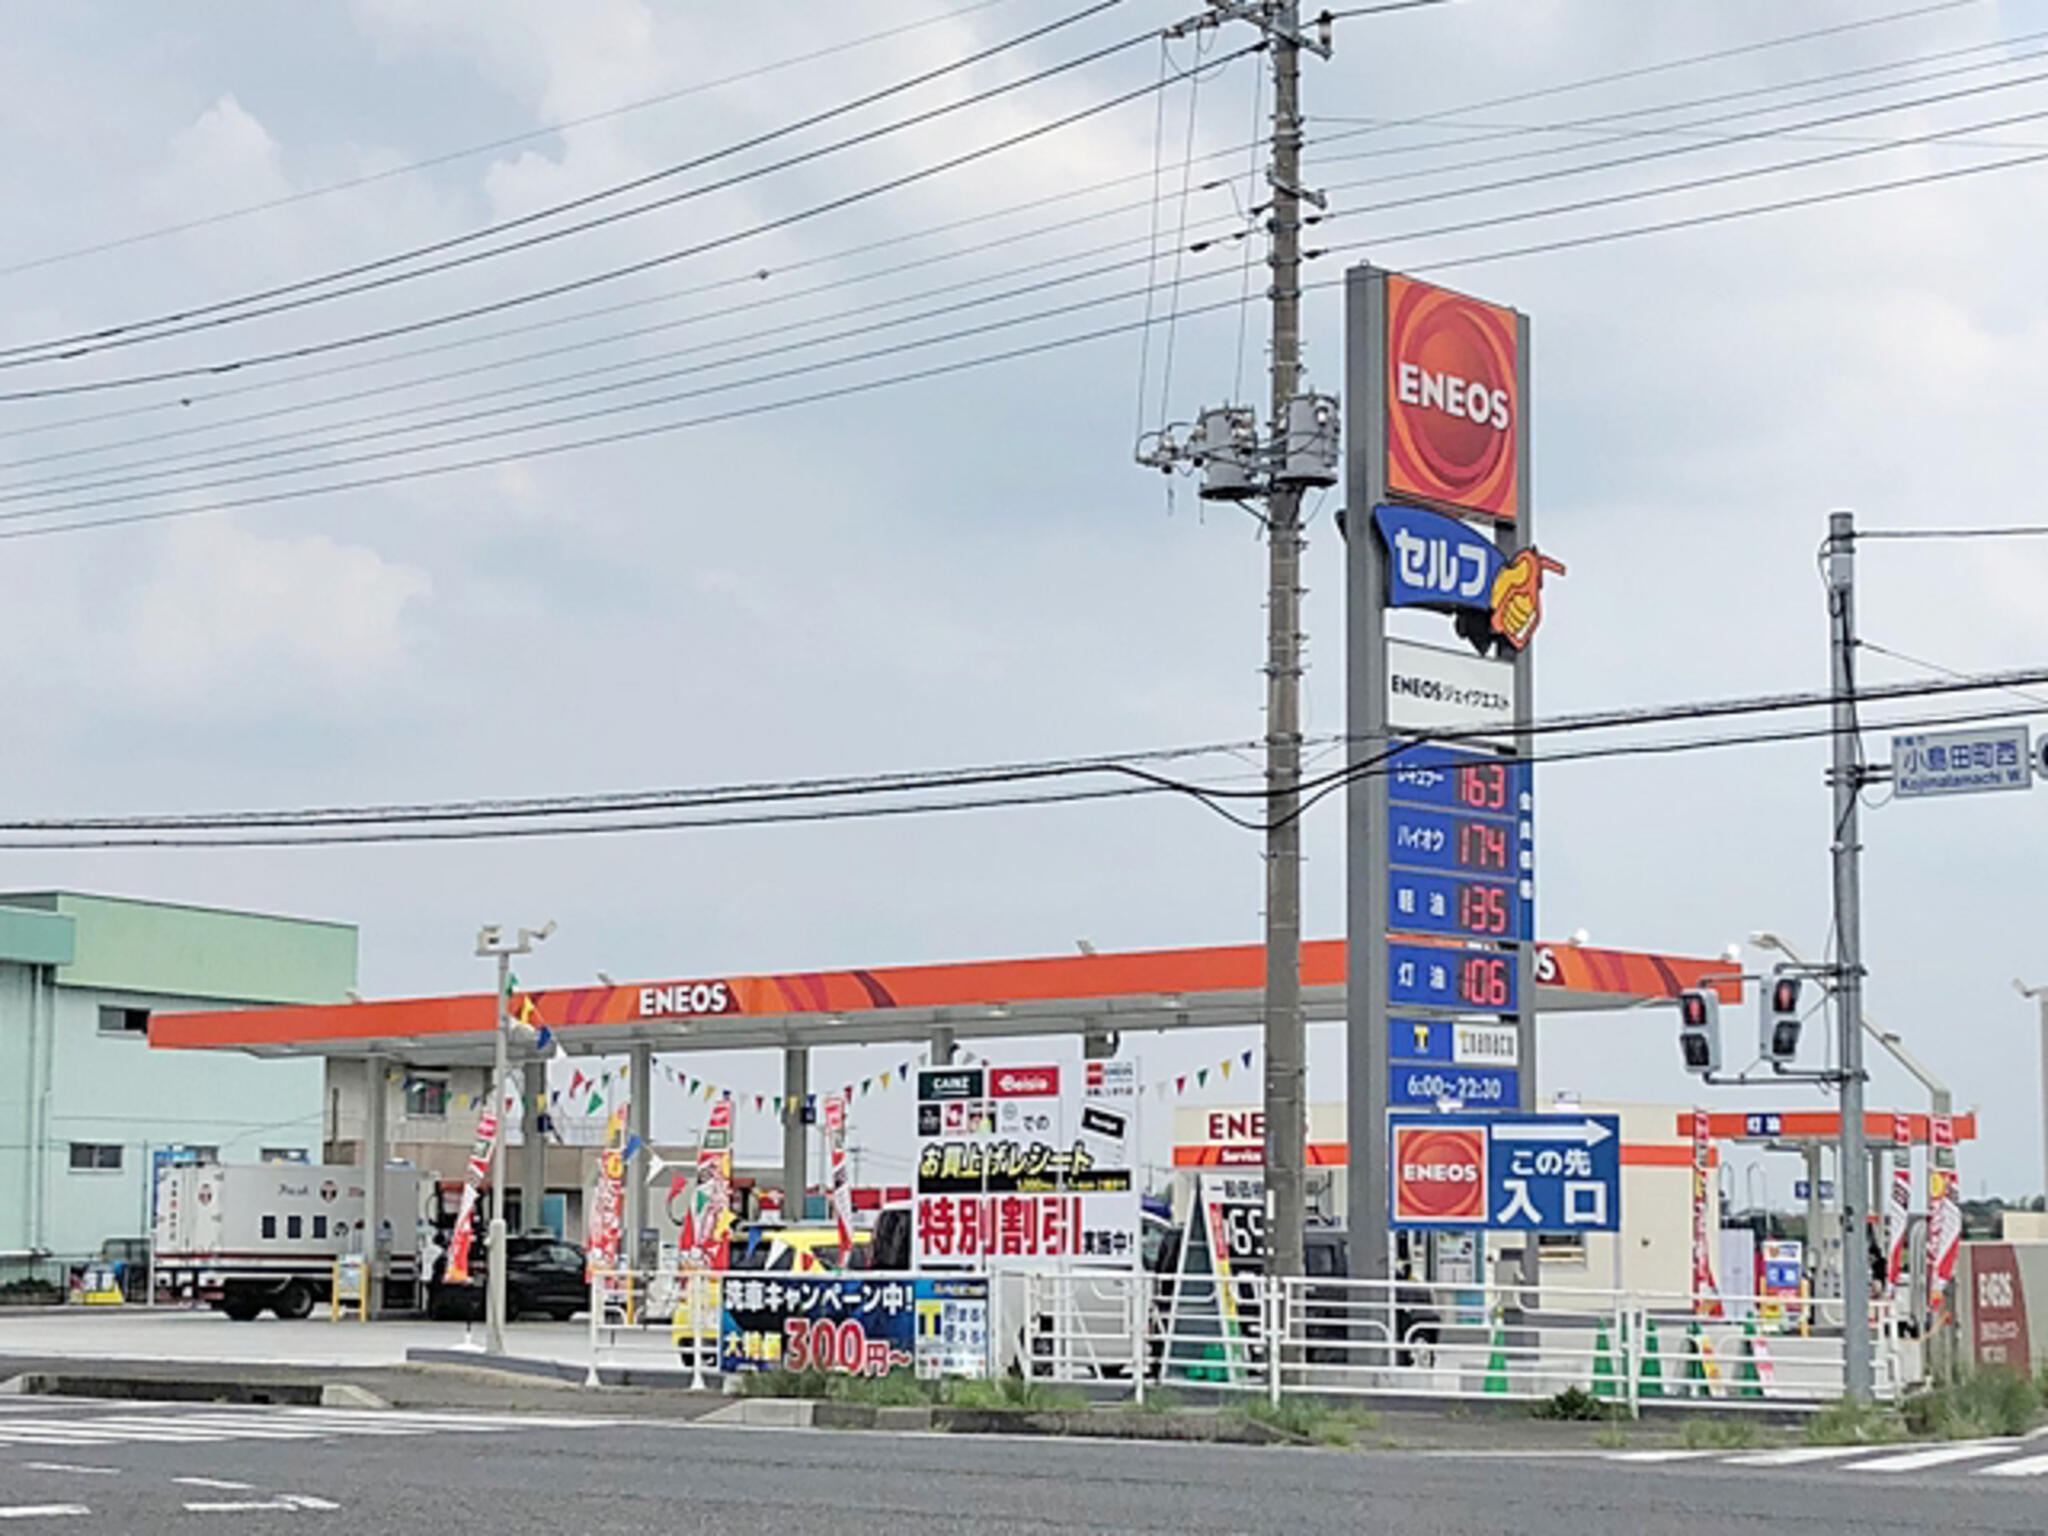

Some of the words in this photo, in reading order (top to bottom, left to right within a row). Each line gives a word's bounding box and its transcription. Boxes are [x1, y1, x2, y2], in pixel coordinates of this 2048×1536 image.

[1399, 362, 1509, 430] ENEOS
[1395, 528, 1488, 597] セルフ
[1461, 763, 1505, 807] 163
[1461, 824, 1505, 869] 174
[1461, 885, 1505, 933] 135
[639, 984, 727, 1016] ENEOS
[1463, 959, 1505, 1005] 106
[1023, 1115, 1050, 1131] での
[1209, 1113, 1266, 1140] ENE
[1402, 1163, 1478, 1182] ENEOS
[1511, 1149, 1592, 1176] この先
[1497, 1179, 1607, 1224] 入口
[918, 1196, 1082, 1255] 特別割引
[725, 1279, 914, 1315] 洗車キャンペーン中!
